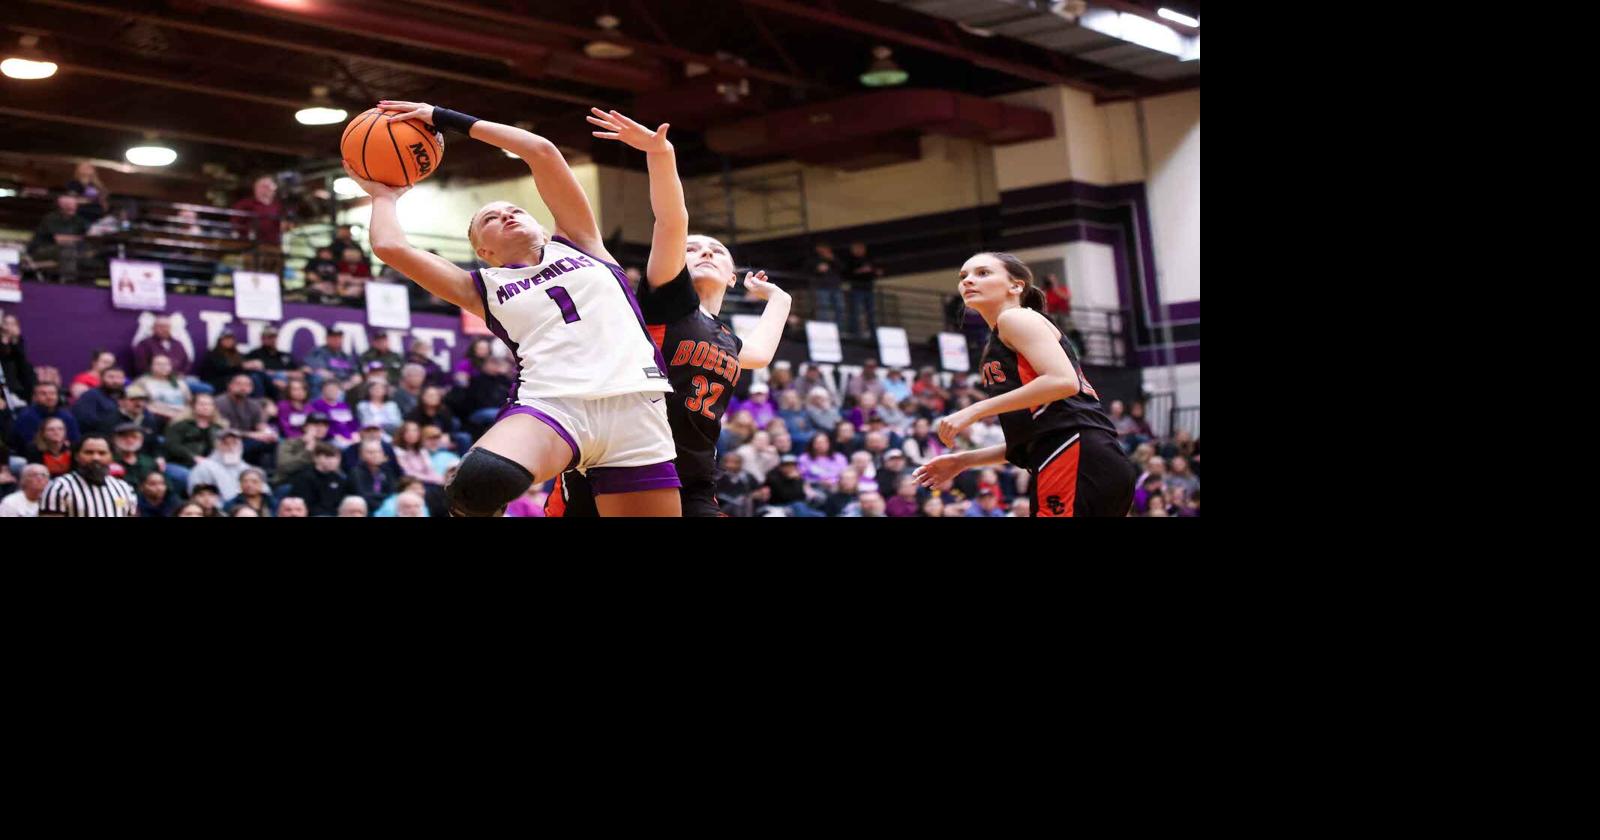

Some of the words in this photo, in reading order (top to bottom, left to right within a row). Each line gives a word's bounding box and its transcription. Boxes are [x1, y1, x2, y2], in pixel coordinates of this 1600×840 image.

[496, 255, 596, 305] MAVERICKS
[545, 286, 581, 324] 1
[685, 374, 725, 420] 32
